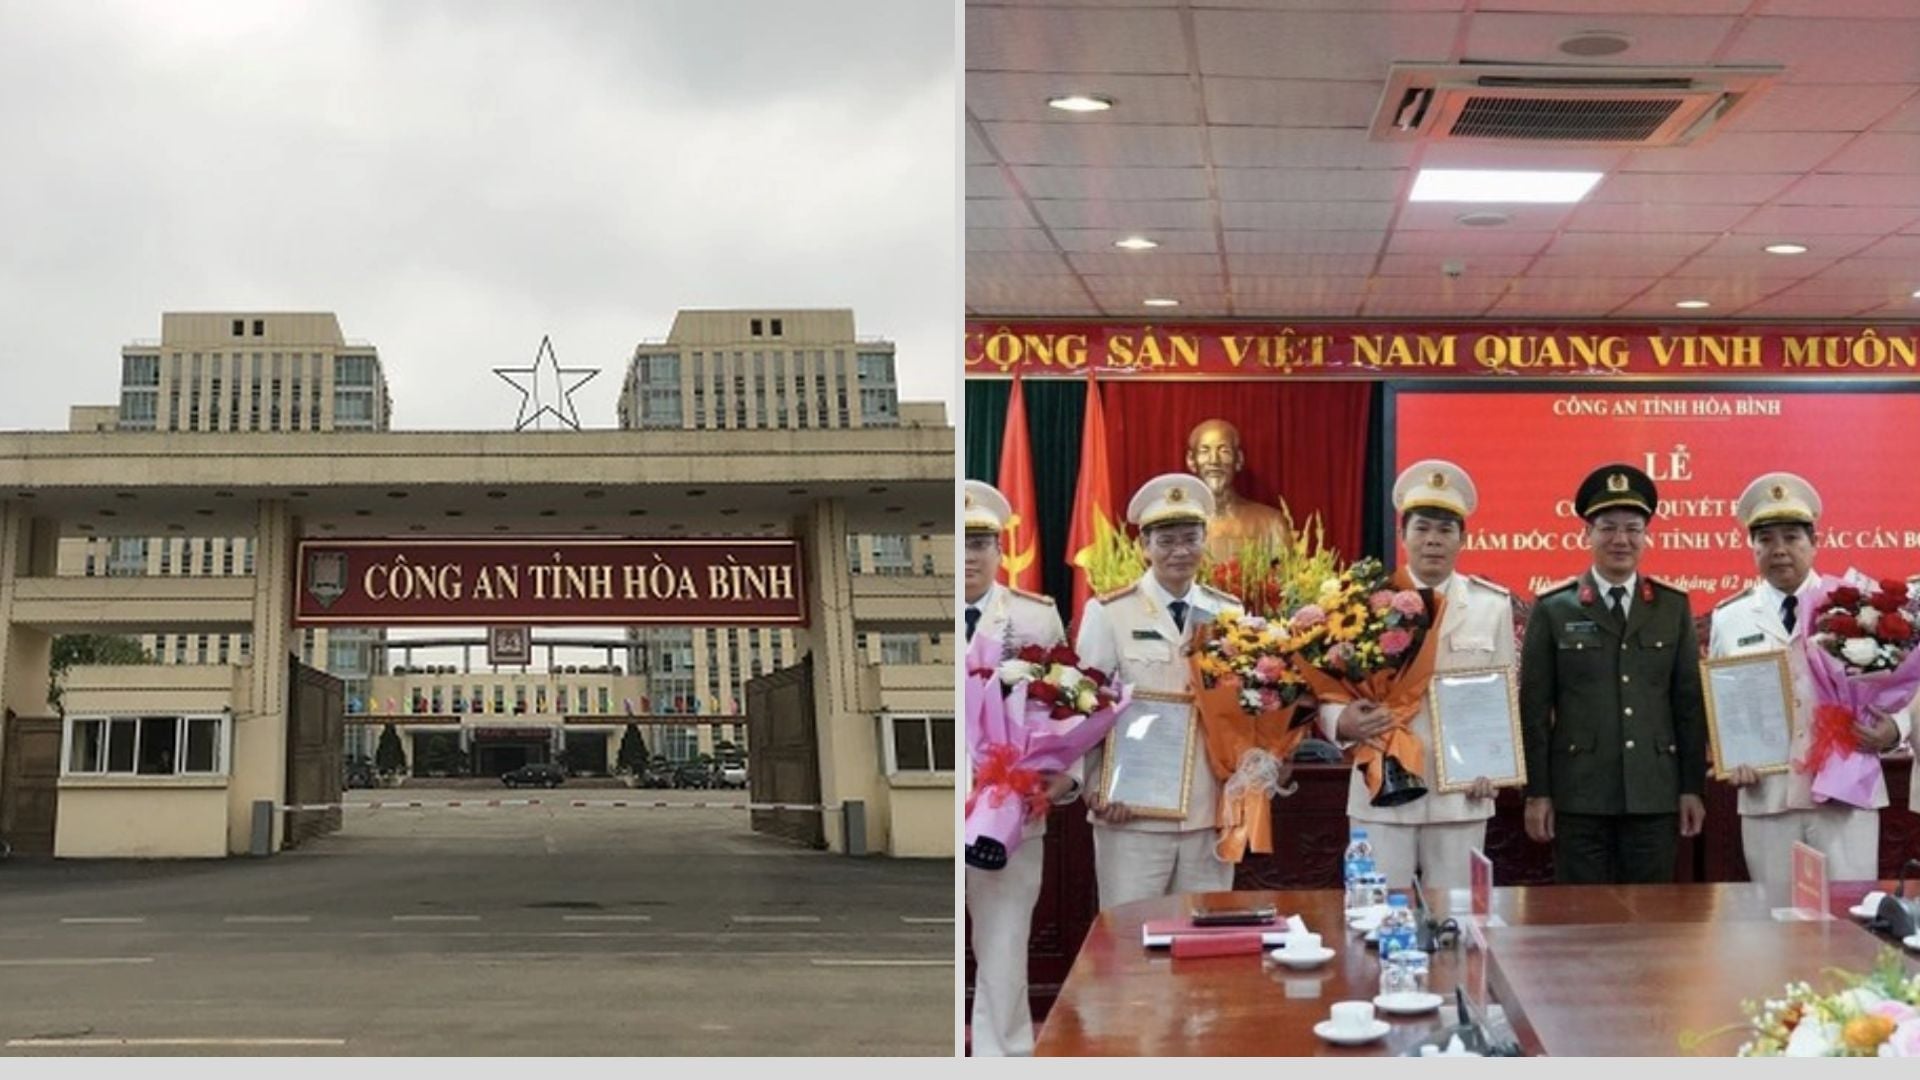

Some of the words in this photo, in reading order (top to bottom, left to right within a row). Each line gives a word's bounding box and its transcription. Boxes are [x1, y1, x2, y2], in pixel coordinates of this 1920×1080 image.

[1220, 327, 1334, 370] VIỆT
[1351, 335, 1457, 367] NAM
[1474, 334, 1630, 374] QUANG
[1648, 336, 1762, 367] VINH
[1782, 328, 1919, 368] MUÔN
[1553, 395, 1608, 416] CÔNG
[1612, 399, 1637, 415] AN
[1736, 395, 1781, 415] BÌNH
[364, 554, 462, 600] CÔNG
[472, 566, 518, 599] AN
[528, 552, 613, 599] TỈNH
[623, 552, 698, 599] HÒA
[708, 554, 794, 600] BÌNH
[1722, 575, 1740, 589] 02
